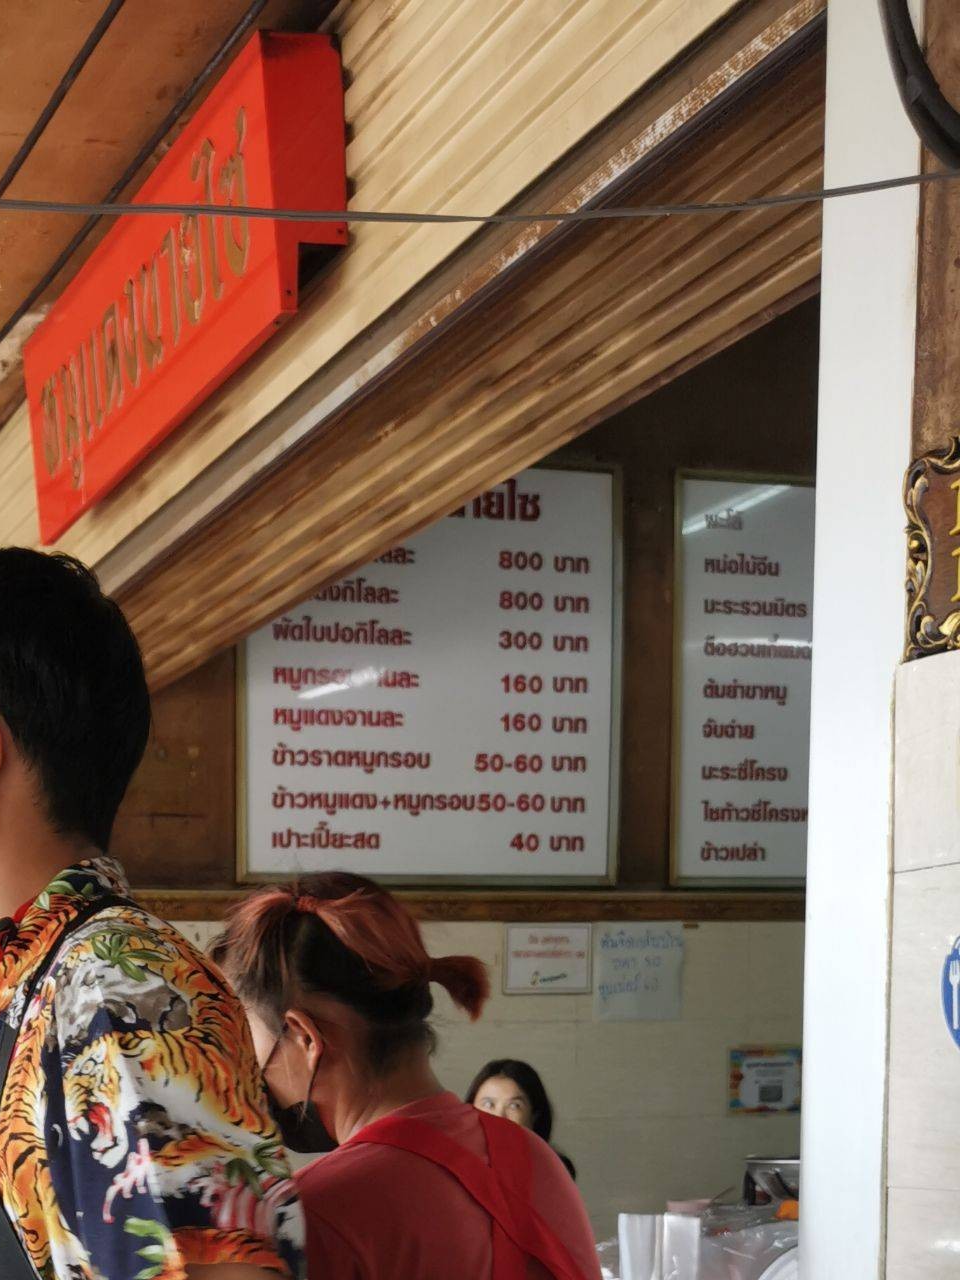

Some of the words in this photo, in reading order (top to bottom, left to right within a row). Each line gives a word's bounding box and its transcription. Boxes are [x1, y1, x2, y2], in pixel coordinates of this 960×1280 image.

[499, 550, 543, 571] 800
[553, 555, 590, 574] บาท
[499, 590, 544, 611] 800
[553, 595, 590, 614] บาท
[498, 630, 543, 651] 300
[553, 635, 589, 653] บาท
[500, 673, 543, 694] 160
[552, 677, 588, 694] บาท
[500, 712, 542, 732] 160
[552, 716, 588, 734] บาท
[474, 753, 543, 773] 50-60
[551, 755, 587, 773] บาท
[550, 795, 586, 813] บาท
[509, 832, 540, 852] 40
[549, 834, 585, 852] บาท
